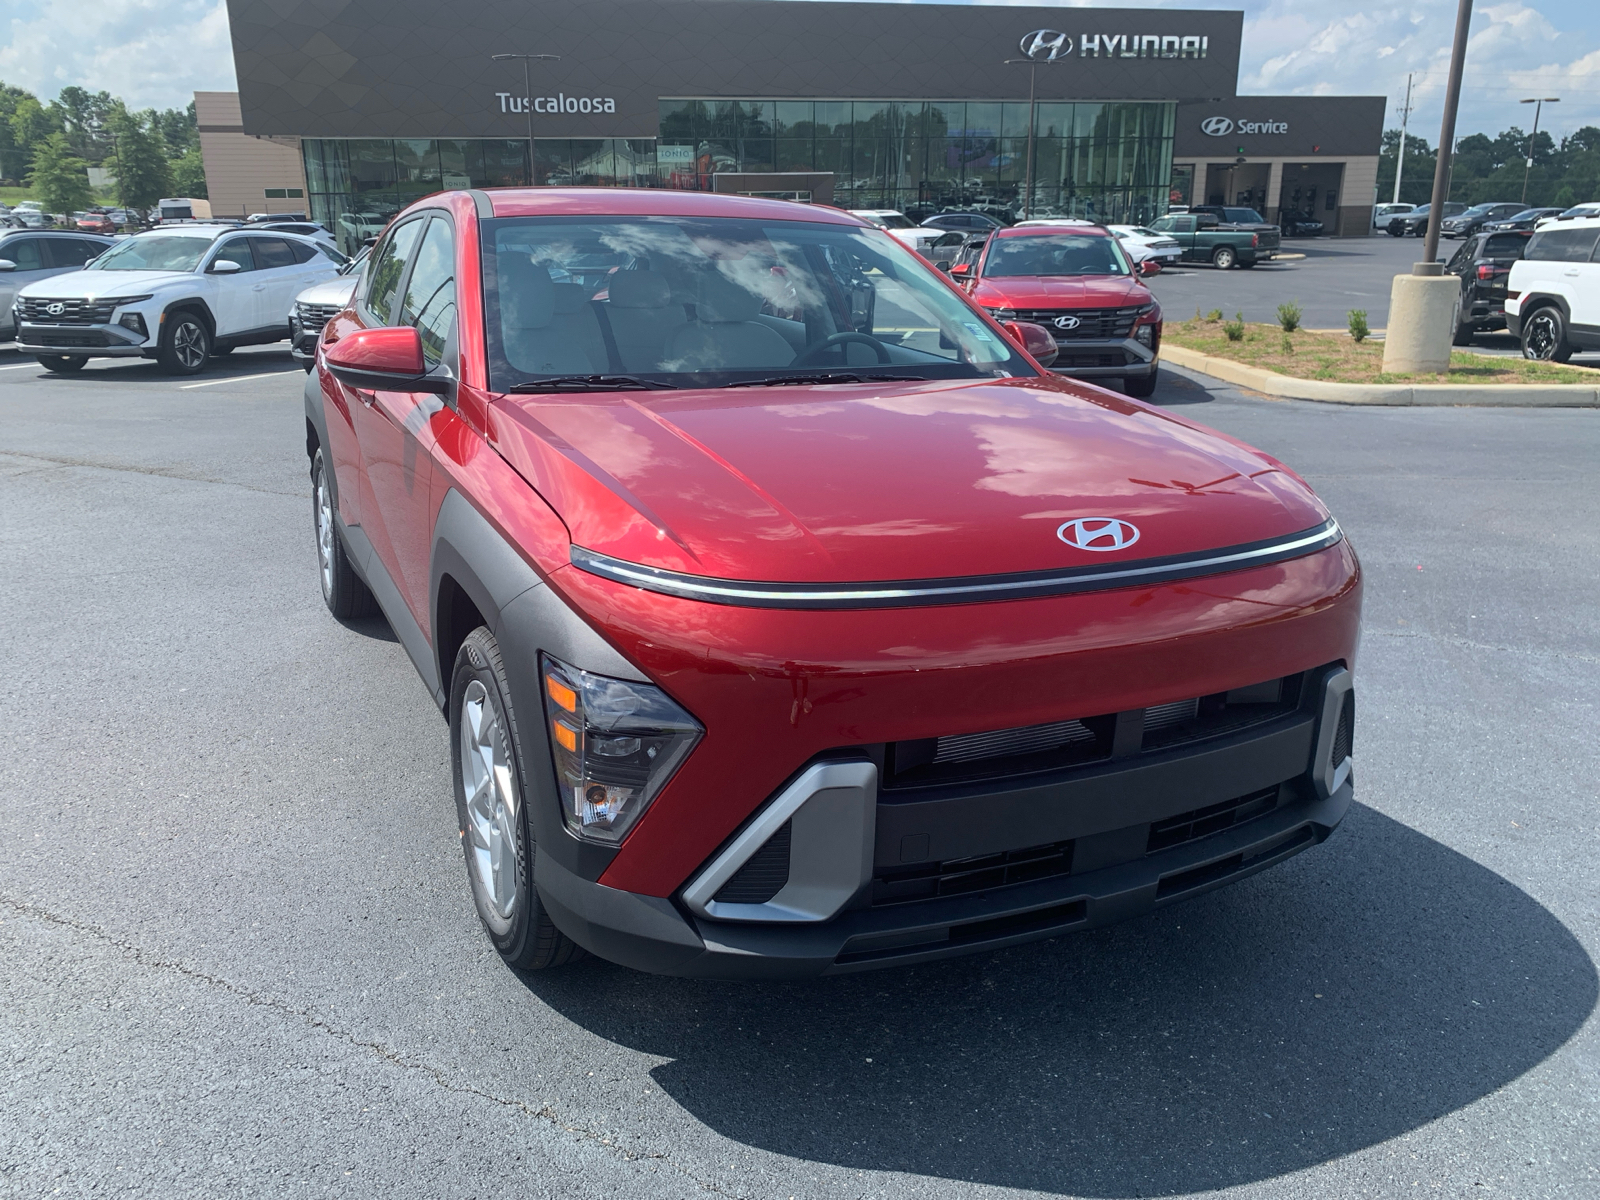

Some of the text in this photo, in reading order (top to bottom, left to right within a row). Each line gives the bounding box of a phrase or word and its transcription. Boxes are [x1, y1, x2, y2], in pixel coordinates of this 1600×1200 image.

[1080, 33, 1208, 59] HYUNDAI
[495, 92, 616, 113] Tuscaloosa
[1236, 118, 1288, 134] Service
